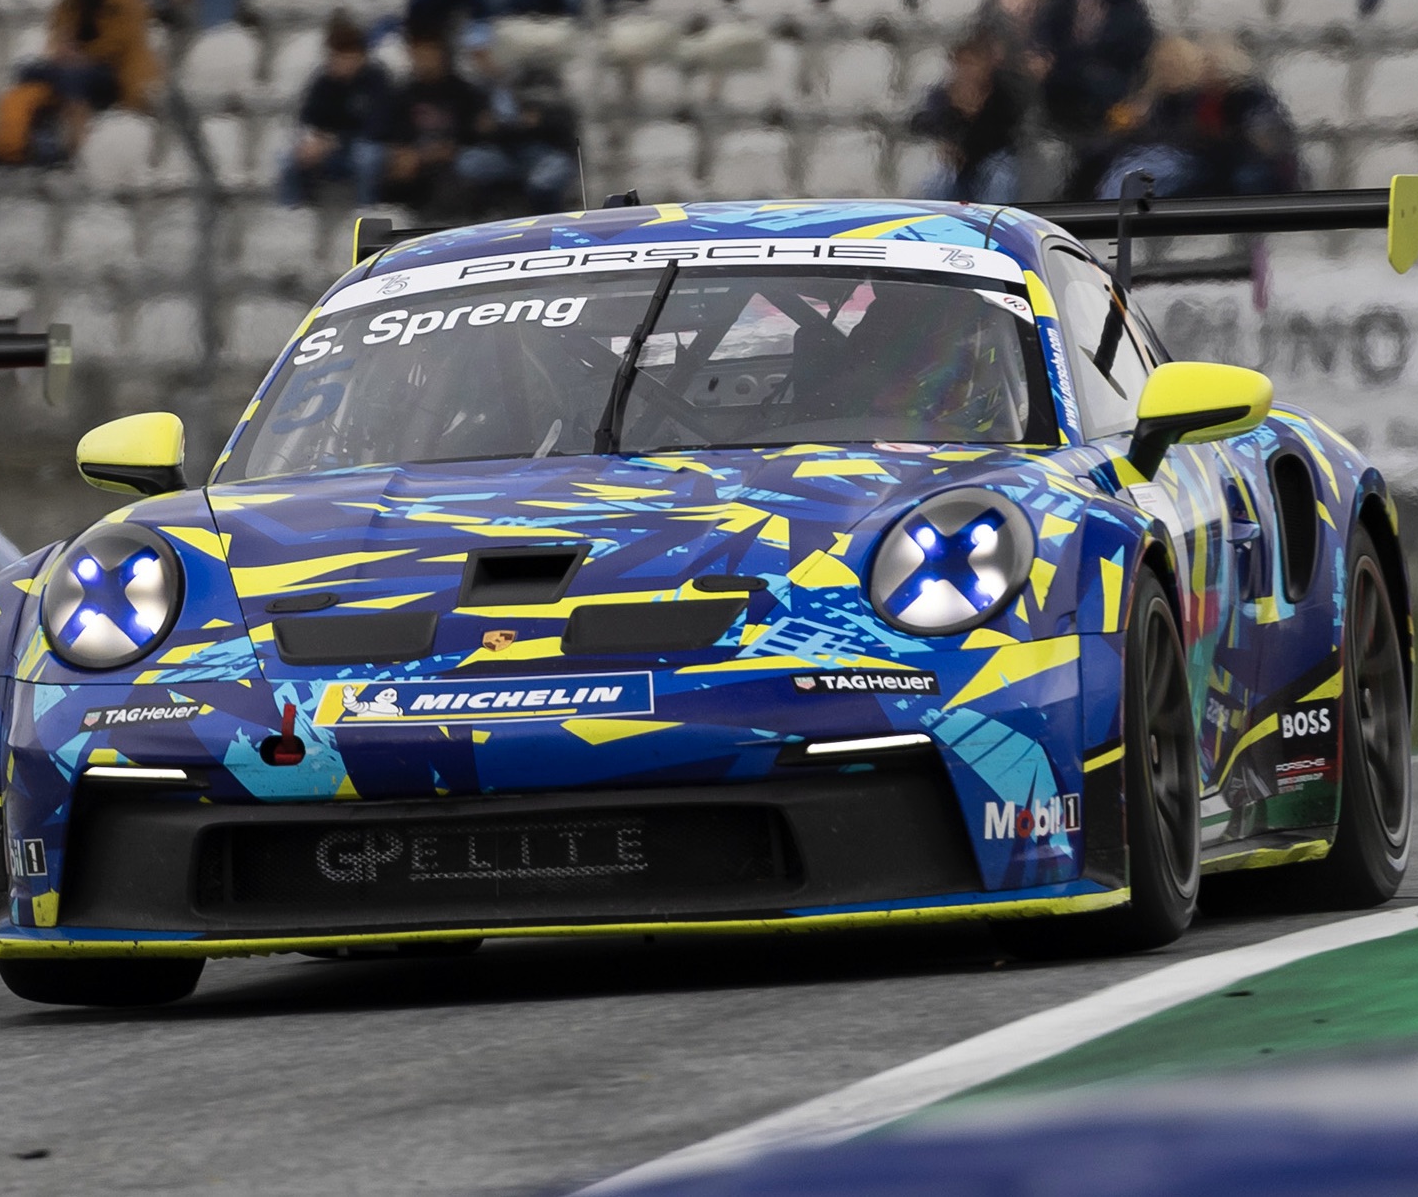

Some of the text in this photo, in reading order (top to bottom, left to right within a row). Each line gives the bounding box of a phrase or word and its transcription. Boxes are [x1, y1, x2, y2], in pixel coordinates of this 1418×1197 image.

[458, 244, 886, 278] PORSCHE
[293, 296, 588, 366] S. Spreng
[271, 358, 356, 434] 5
[409, 686, 623, 711] MICHELIN
[1282, 708, 1331, 739] BOSS
[1275, 757, 1326, 772] PORSCHE
[984, 795, 1061, 840] Mobil
